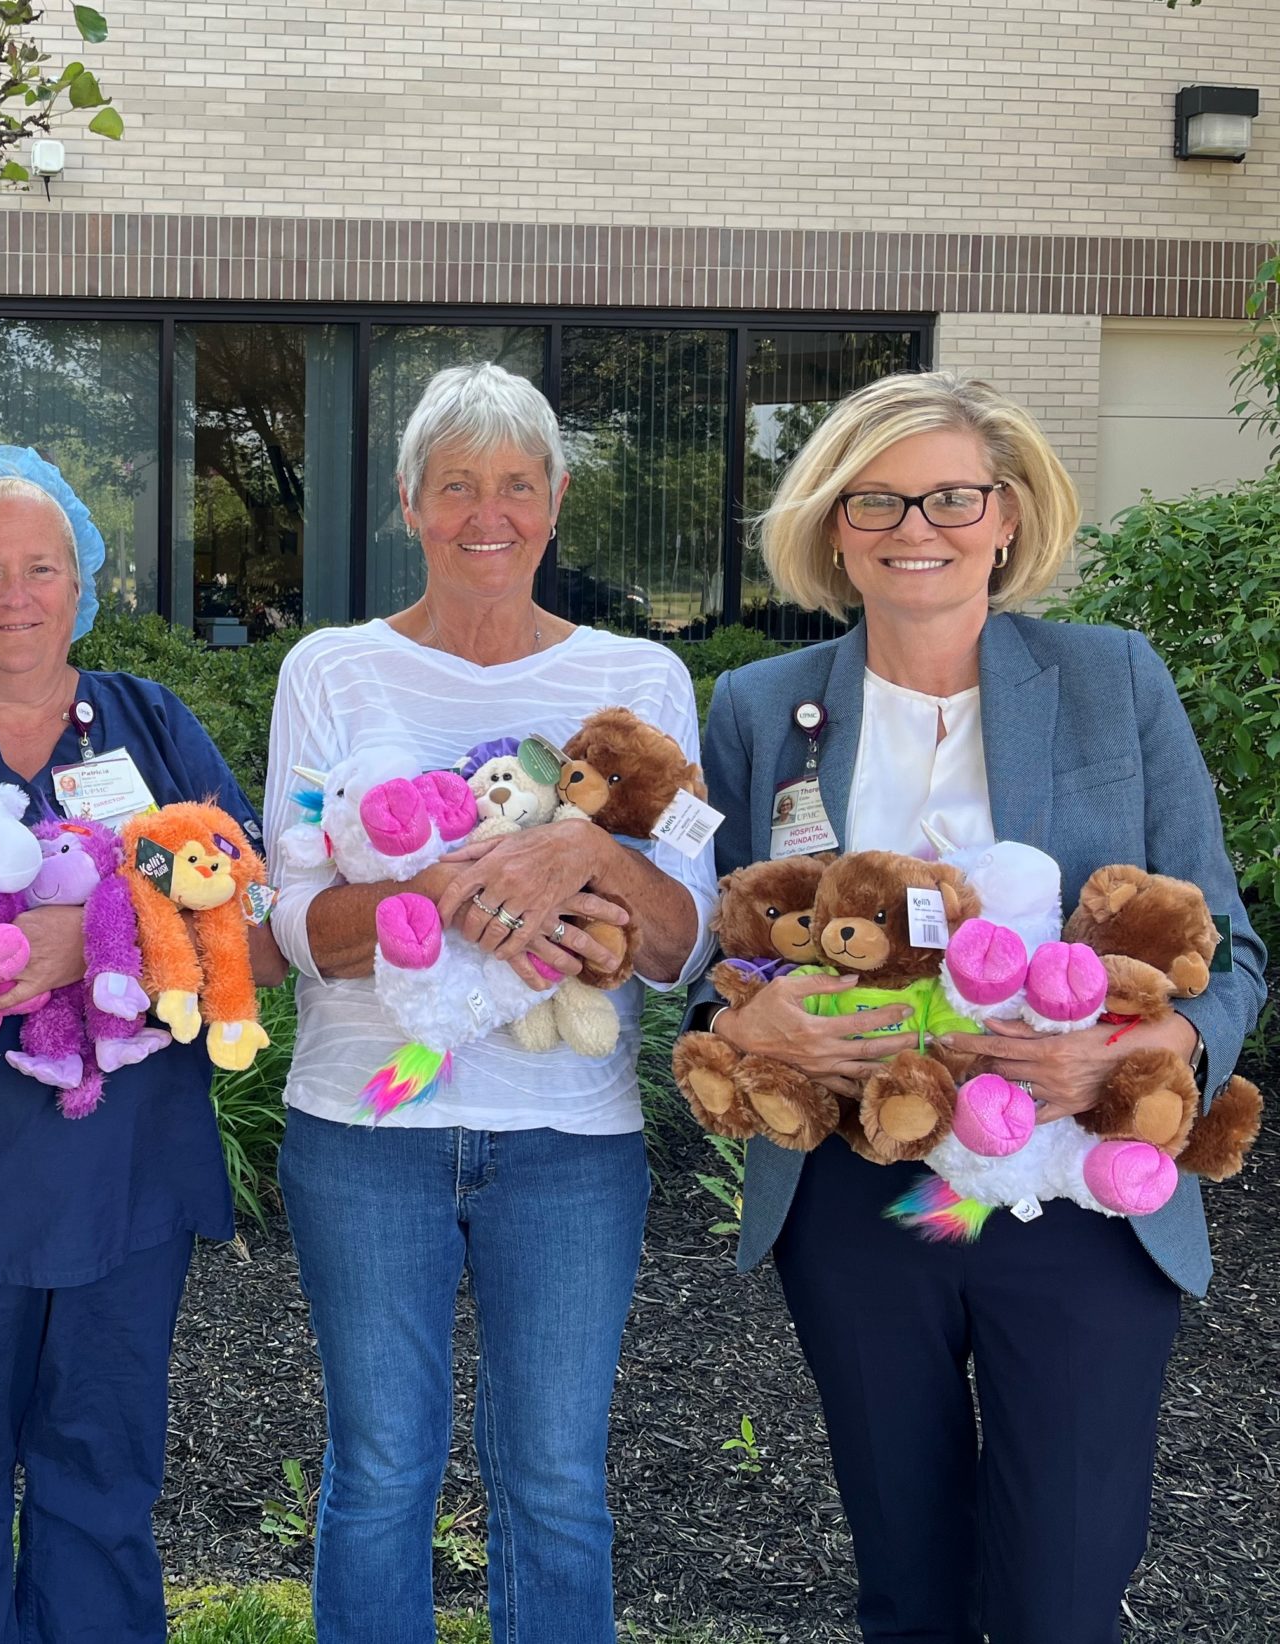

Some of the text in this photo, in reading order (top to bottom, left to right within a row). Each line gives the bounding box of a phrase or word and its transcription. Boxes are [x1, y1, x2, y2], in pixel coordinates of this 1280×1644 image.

[797, 811, 819, 820] UPMC
[790, 825, 823, 836] HOSPITAL
[784, 833, 828, 846] FOUNDATION
[139, 853, 166, 876] Kelli's
[154, 864, 168, 879] PLUSH
